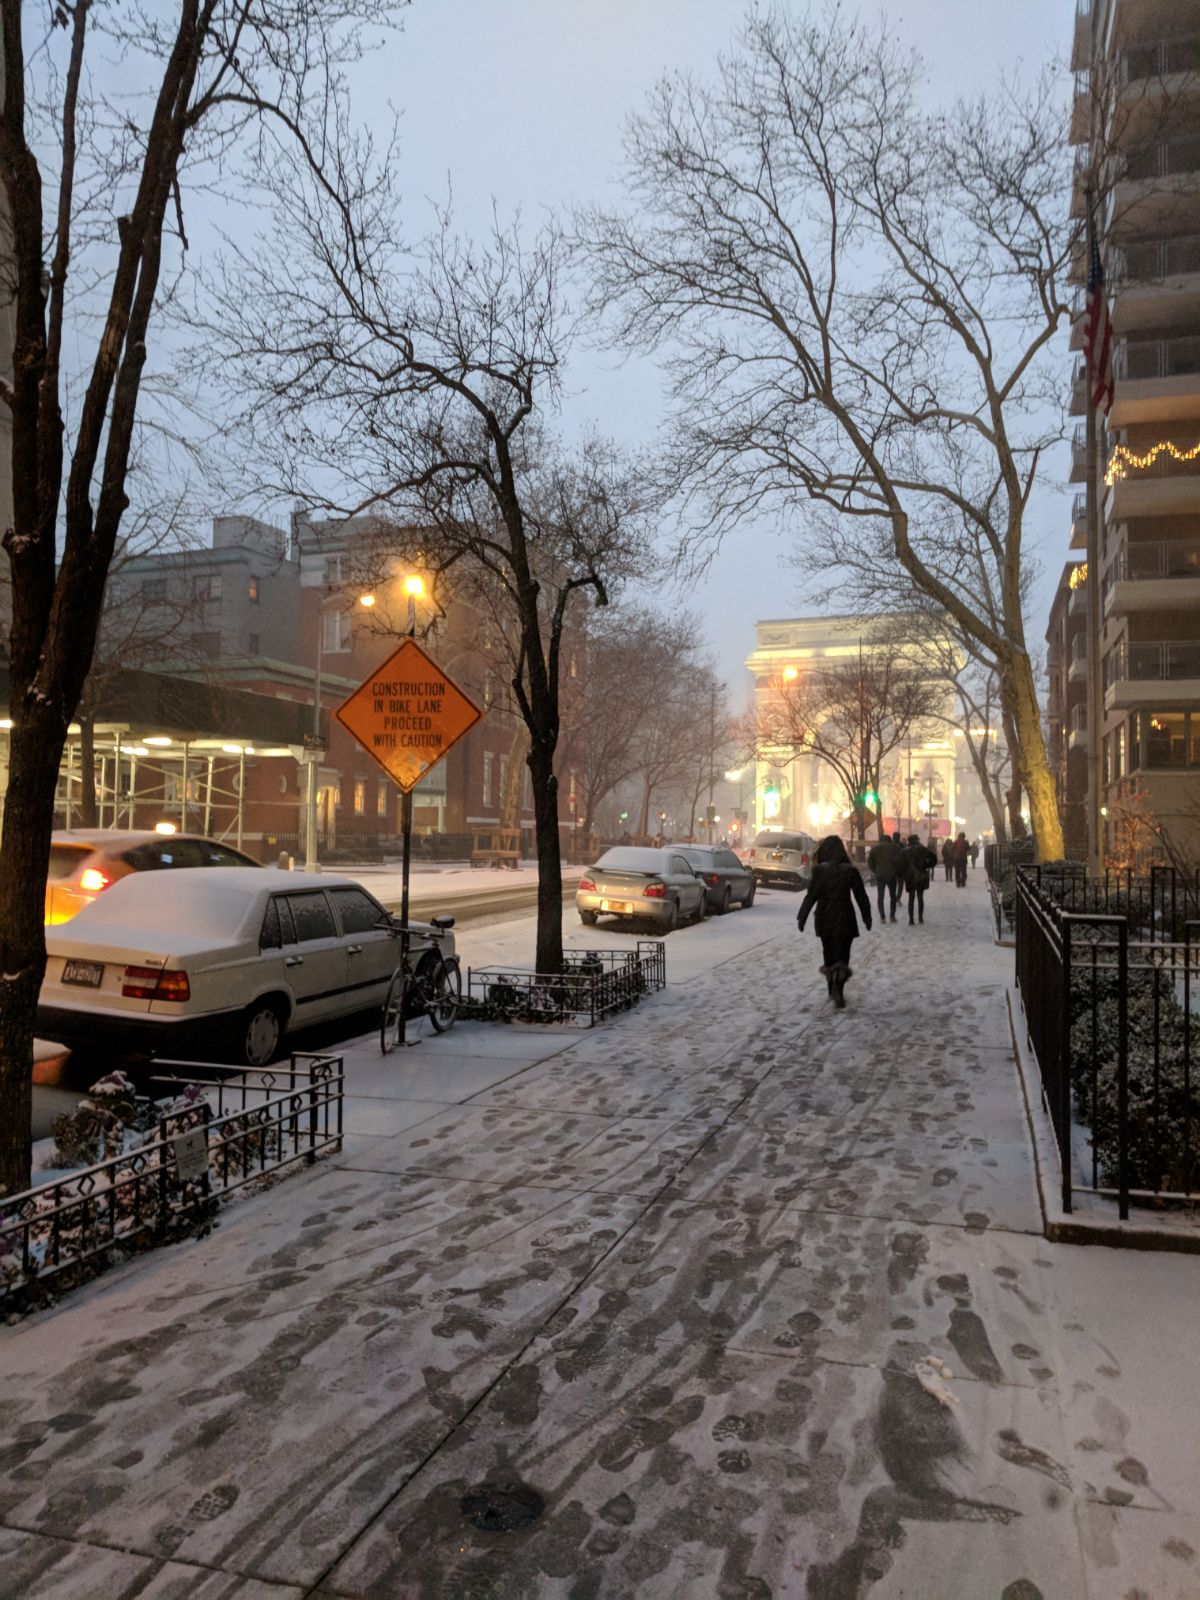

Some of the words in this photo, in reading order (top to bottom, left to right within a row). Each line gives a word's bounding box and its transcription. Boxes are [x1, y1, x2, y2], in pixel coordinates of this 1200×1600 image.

[372, 682, 446, 696] CONSTRUCTION
[374, 700, 384, 713] IN
[389, 700, 411, 713] BIKE
[417, 700, 442, 713] LANE
[384, 716, 432, 730] PROCEED
[373, 734, 396, 747] WITH
[401, 734, 442, 748] CAUTION
